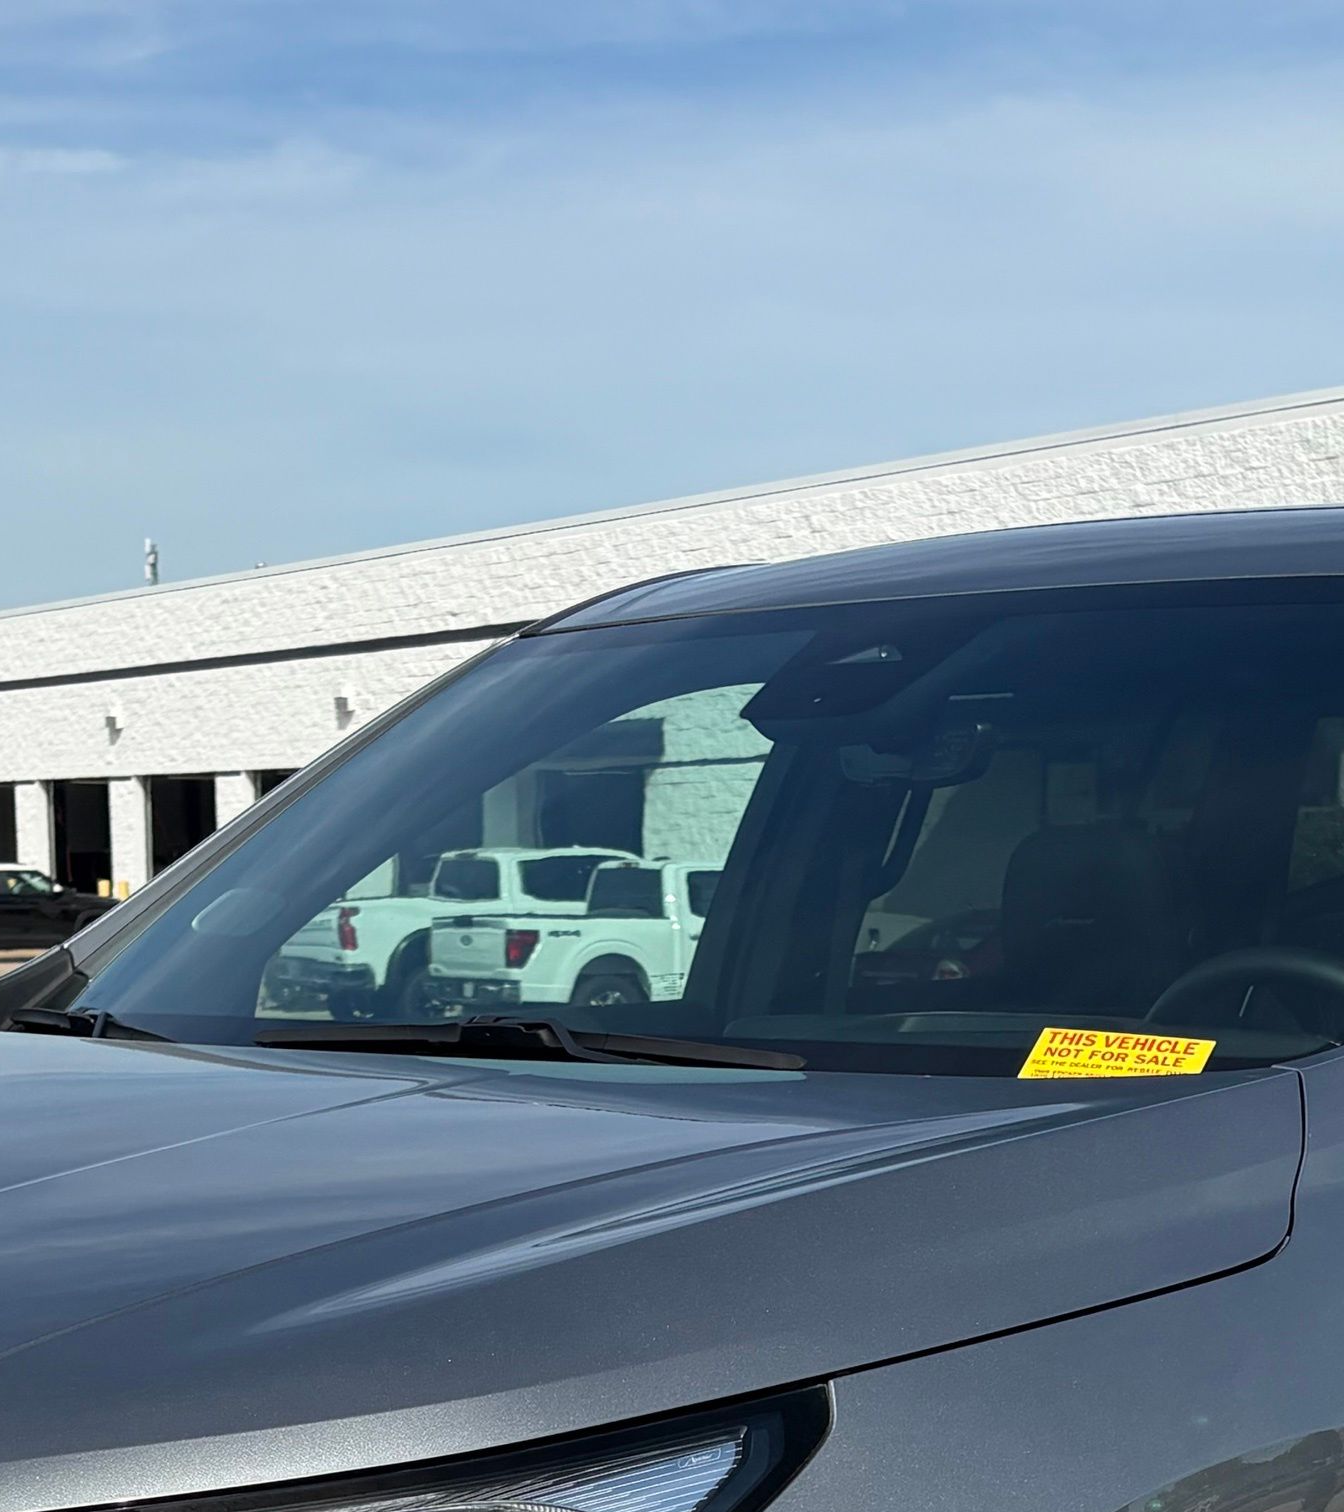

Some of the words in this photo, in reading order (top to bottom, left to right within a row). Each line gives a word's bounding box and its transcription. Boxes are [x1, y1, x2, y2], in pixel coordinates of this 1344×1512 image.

[1047, 1031, 1098, 1047] THIS
[1104, 1035, 1200, 1056] VEHICLE
[1043, 1046, 1084, 1060] NOT
[1088, 1050, 1130, 1063] FOR
[1134, 1054, 1187, 1068] SALE
